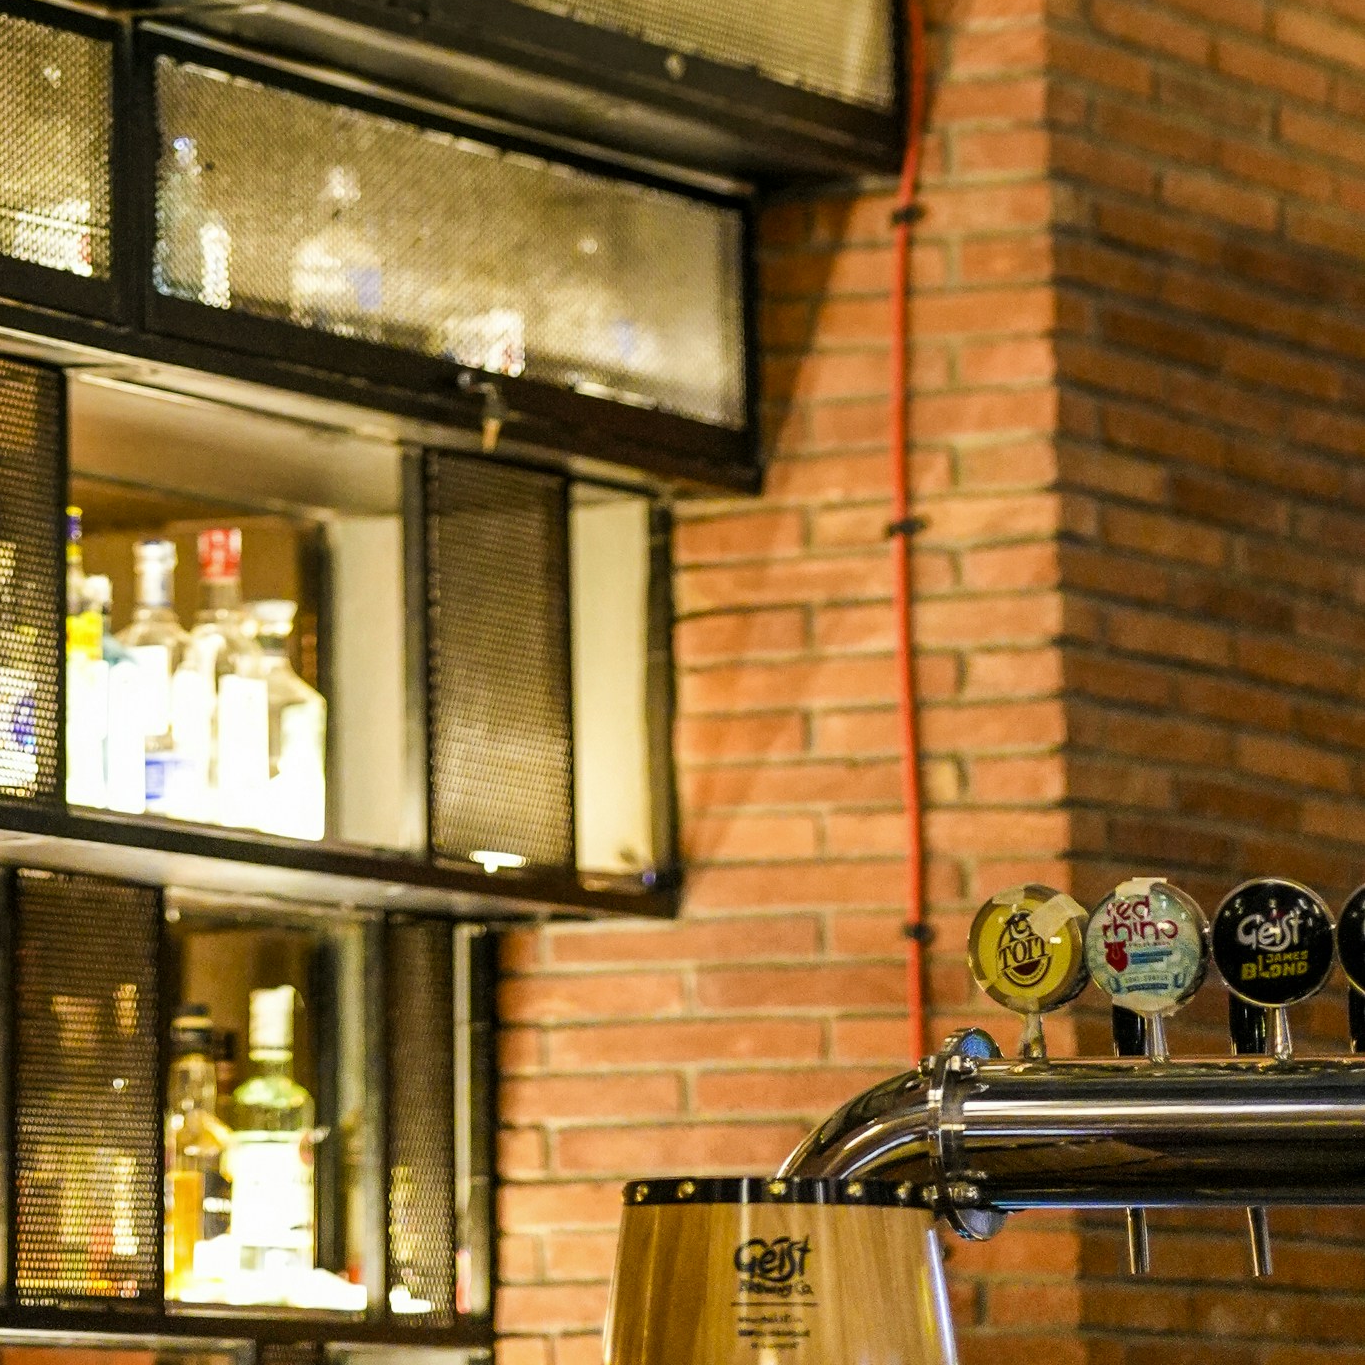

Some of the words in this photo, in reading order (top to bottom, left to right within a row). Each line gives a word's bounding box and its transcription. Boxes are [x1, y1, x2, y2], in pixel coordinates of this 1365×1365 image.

[1106, 895, 1150, 920] red
[1101, 915, 1179, 941] rhino
[1236, 910, 1304, 952] Geist
[997, 936, 1050, 971] TOIT
[1240, 955, 1309, 981] BLOND
[733, 1235, 811, 1282] Geist
